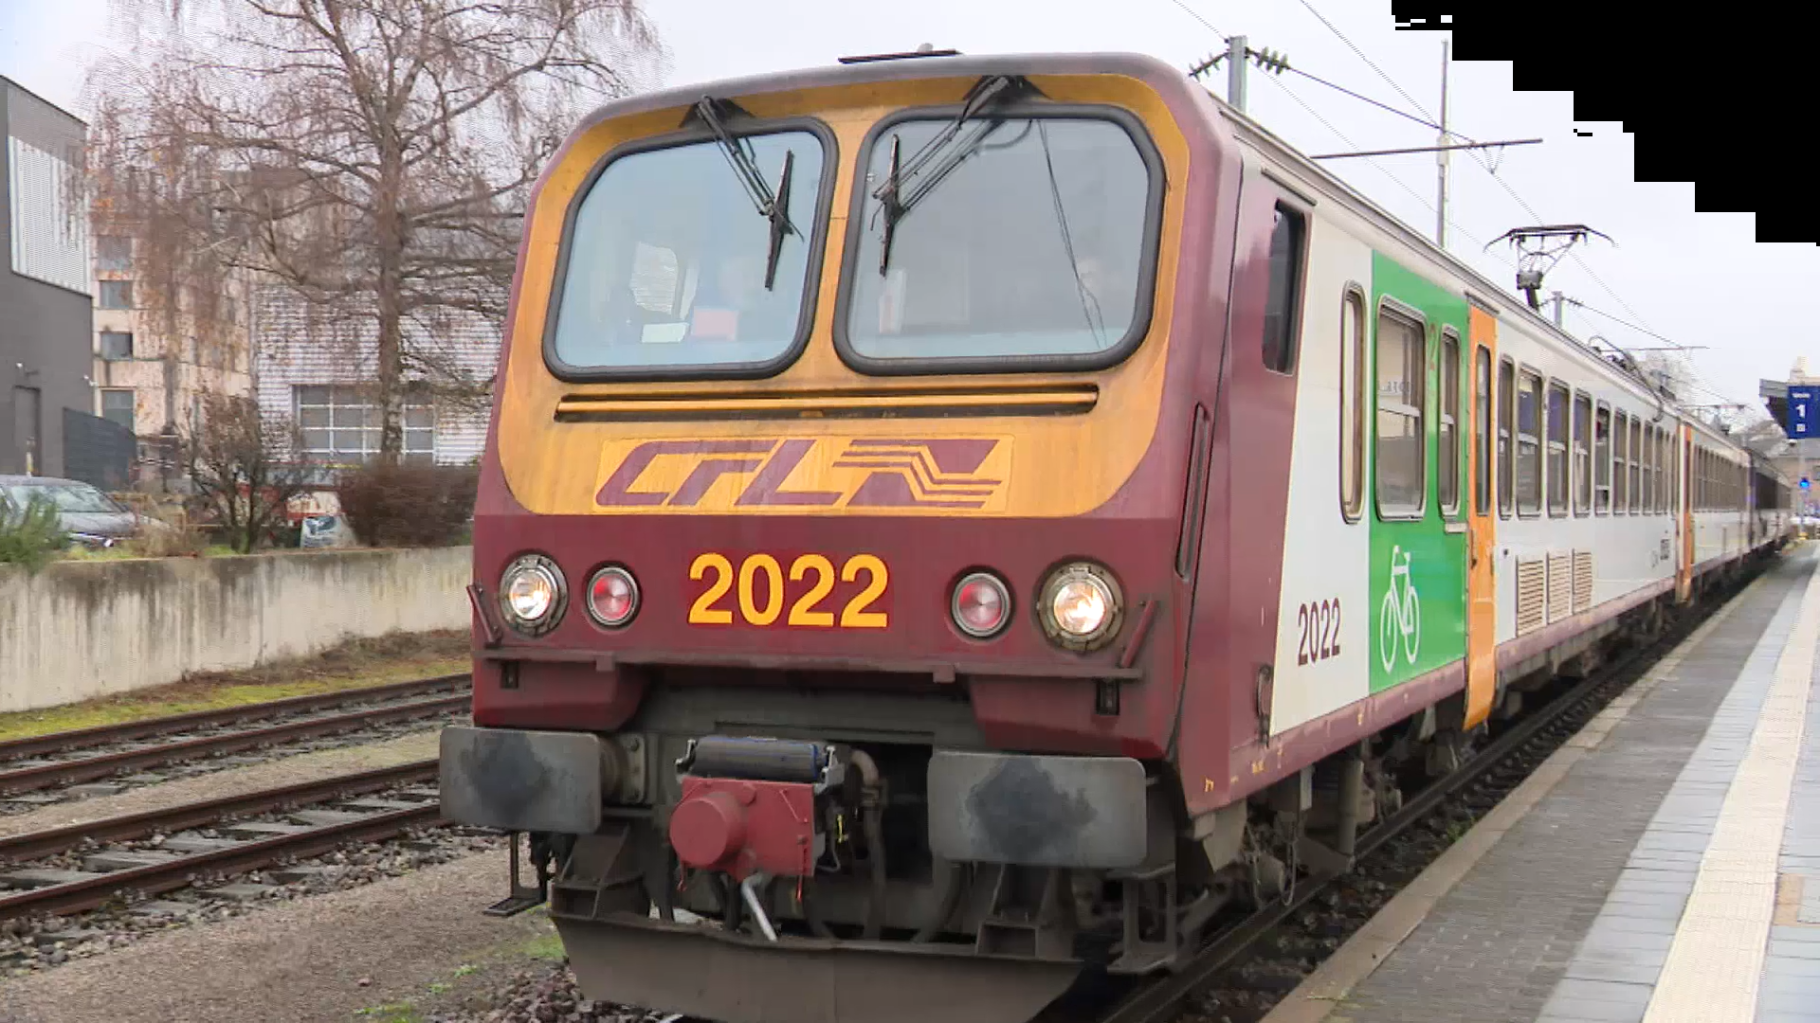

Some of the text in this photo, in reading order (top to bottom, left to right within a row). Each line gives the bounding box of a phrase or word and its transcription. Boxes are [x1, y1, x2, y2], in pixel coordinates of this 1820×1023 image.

[1796, 404, 1806, 418] 1
[595, 438, 843, 506] CFL
[688, 553, 888, 627] 2022
[1297, 597, 1340, 666] 2022
